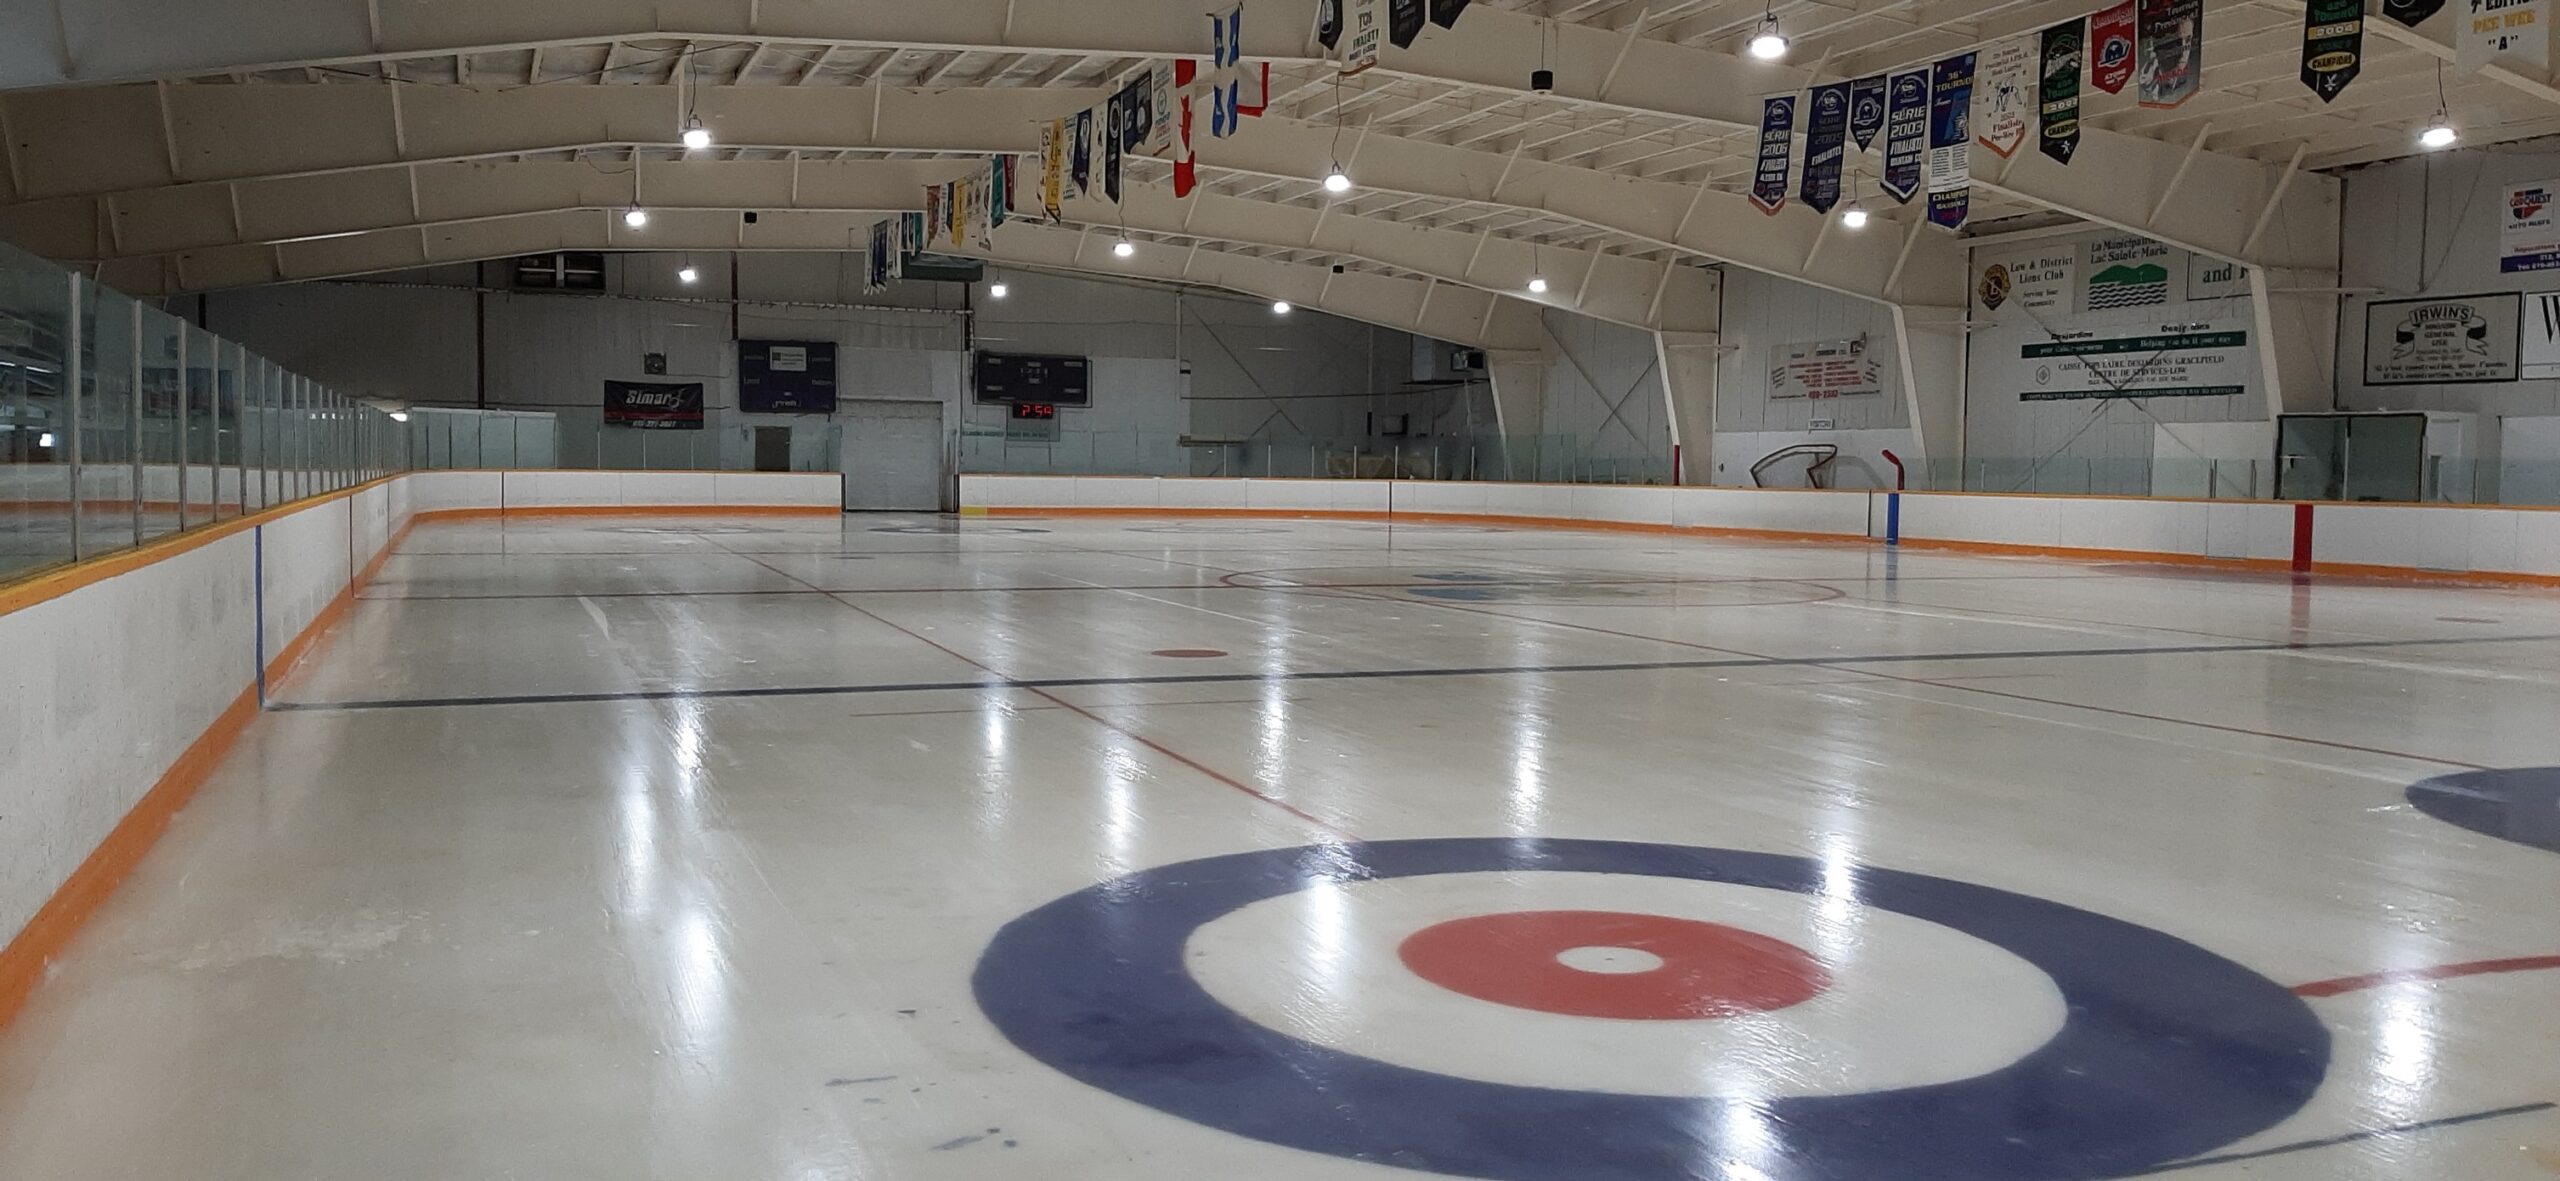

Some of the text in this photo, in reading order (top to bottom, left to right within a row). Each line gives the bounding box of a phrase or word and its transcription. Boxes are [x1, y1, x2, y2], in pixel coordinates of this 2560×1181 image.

[1891, 121, 1925, 138] 2003
[1761, 143, 1788, 156] 2006
[2091, 242, 2102, 252] La
[2029, 261, 2036, 269] &
[2040, 257, 2073, 269] District
[2019, 269, 2064, 284] Lions Club
[2203, 264, 2232, 283] and
[2414, 306, 2470, 322] IRWINS
